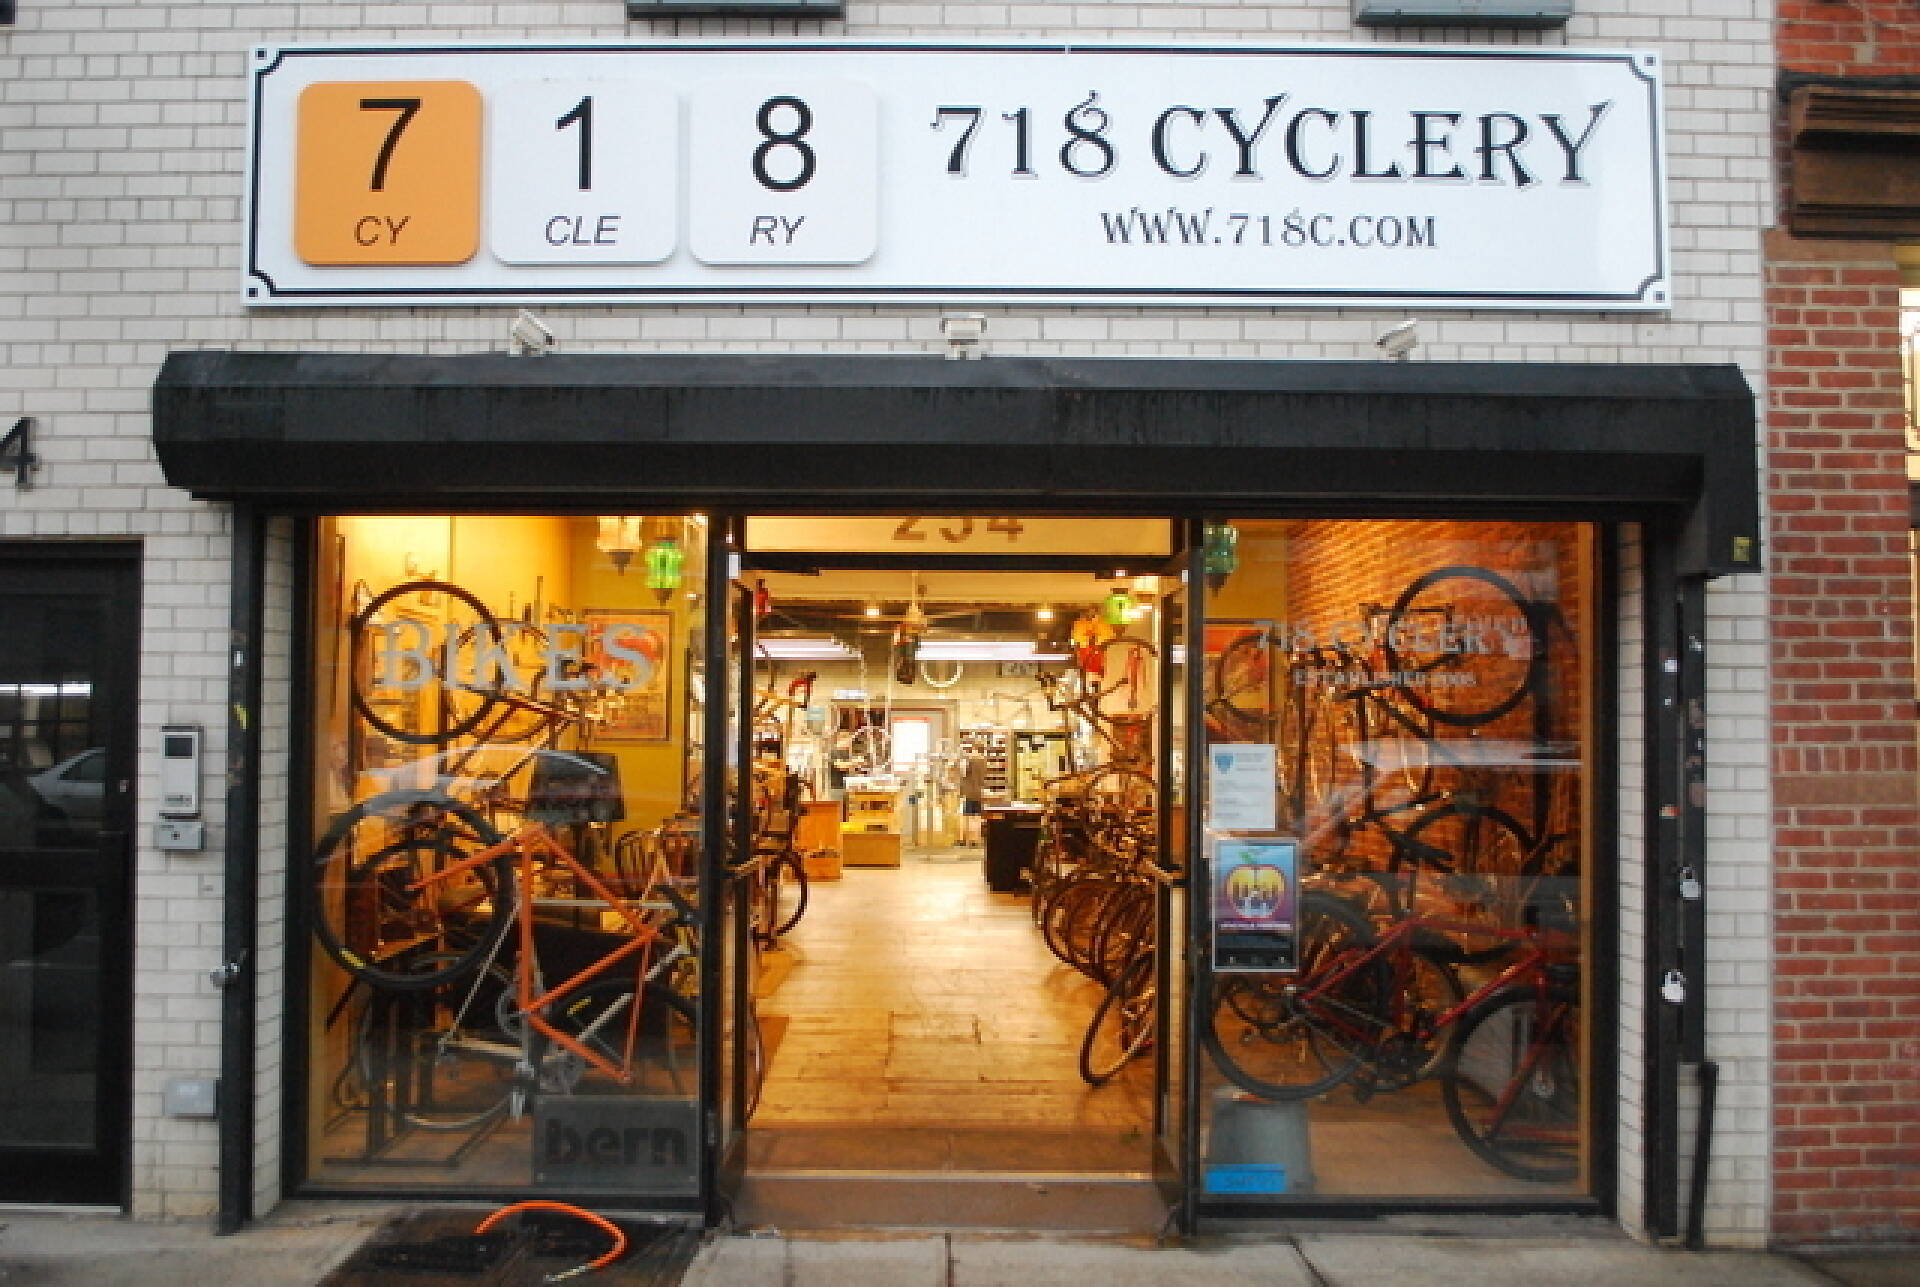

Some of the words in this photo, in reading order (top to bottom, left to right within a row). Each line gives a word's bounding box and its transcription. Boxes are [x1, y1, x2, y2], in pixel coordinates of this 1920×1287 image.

[358, 97, 421, 193] 7
[556, 96, 592, 191] 1
[752, 95, 817, 192] 8
[930, 90, 1119, 180] 718
[1151, 91, 1612, 190] CYCLERY
[353, 215, 410, 246] CY
[544, 215, 621, 246] CLE
[749, 215, 805, 246] RY
[1100, 207, 1438, 248] WWW.718C.COM
[368, 619, 654, 692] BIKES
[545, 1118, 688, 1166] bern
